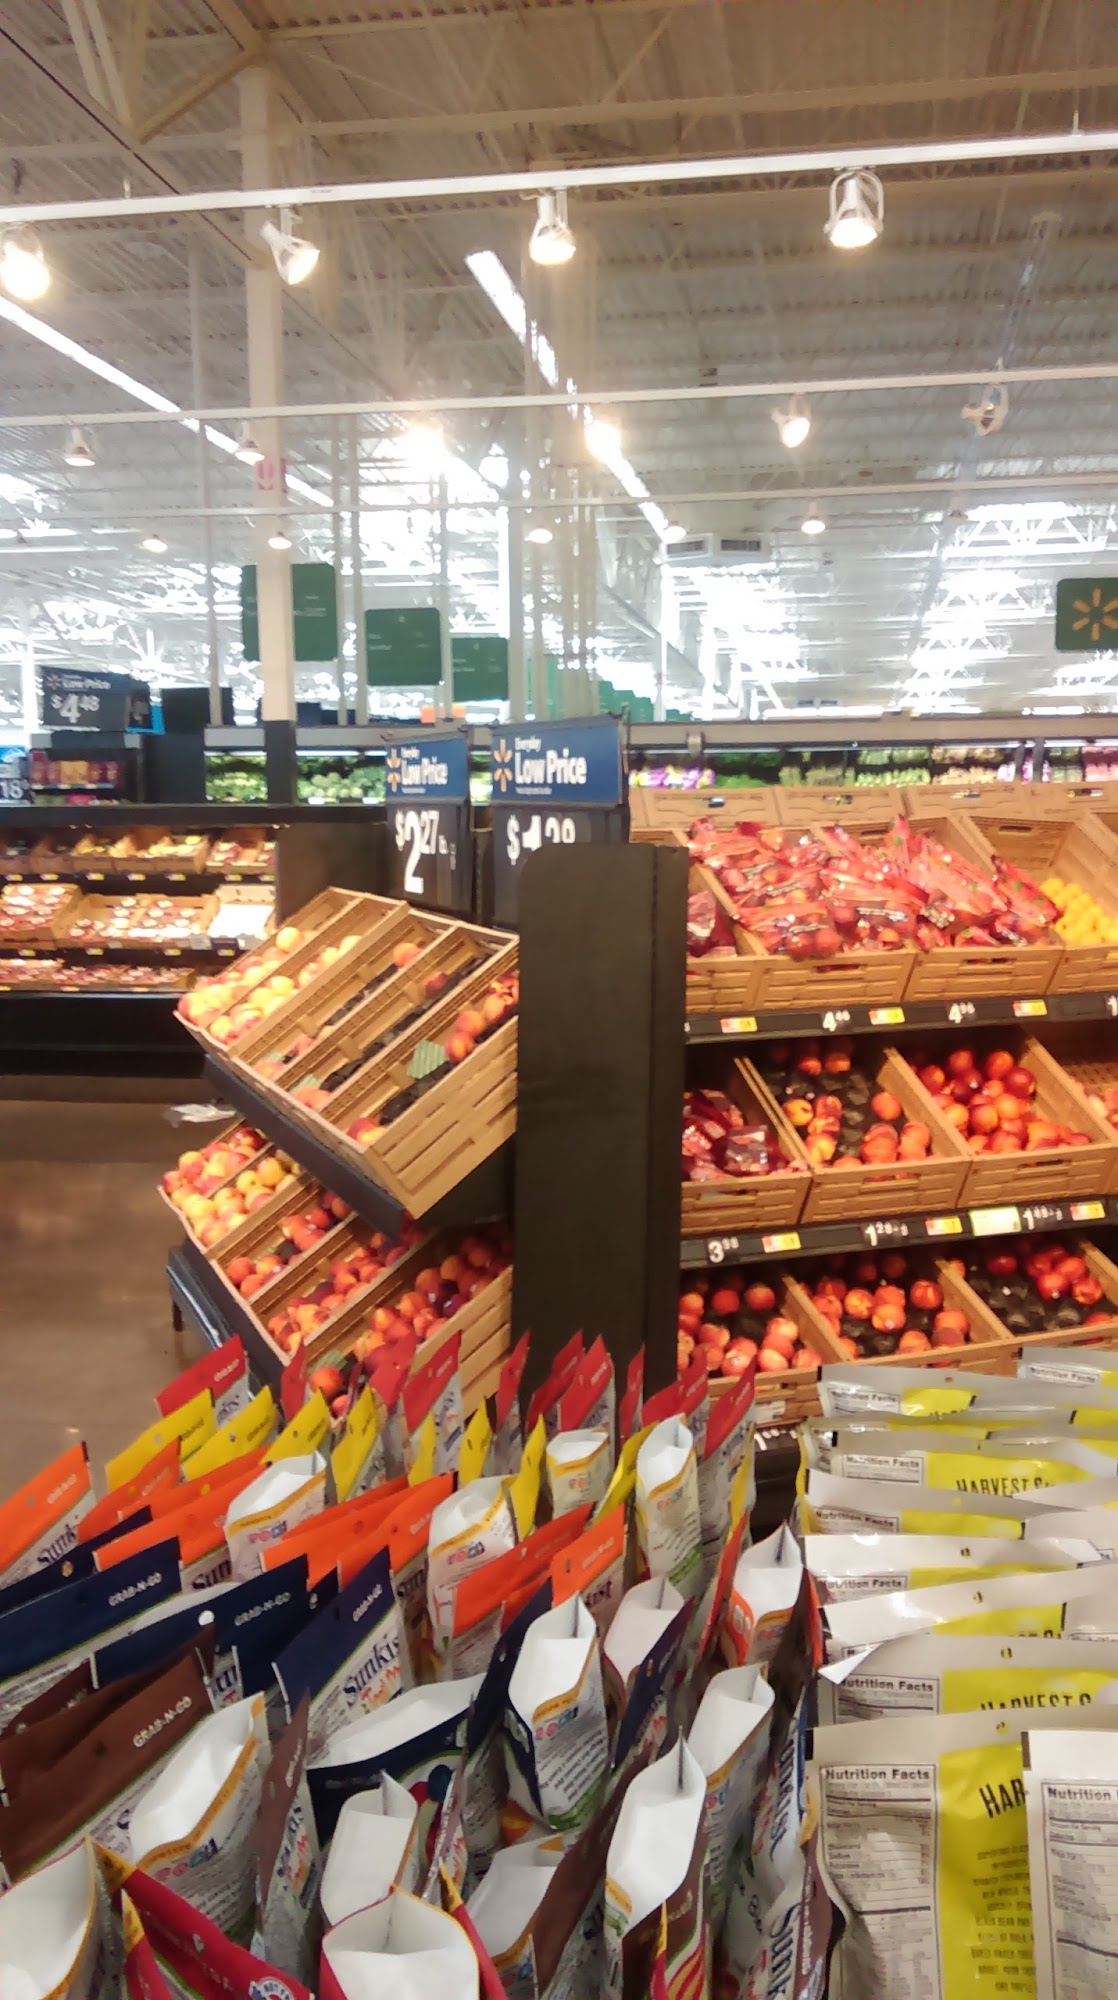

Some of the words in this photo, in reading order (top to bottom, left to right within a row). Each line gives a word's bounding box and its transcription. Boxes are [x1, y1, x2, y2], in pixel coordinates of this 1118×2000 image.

[422, 756, 448, 785] Price
[515, 751, 545, 784] Low
[546, 747, 587, 784] Price
[892, 1458, 920, 1468] Facts
[864, 1517, 894, 1527] Facts
[898, 1679, 934, 1692] Facts
[826, 1768, 887, 1780] Nutrition
[892, 1769, 930, 1780] Facts
[1047, 1786, 1112, 1801] Nutrition
